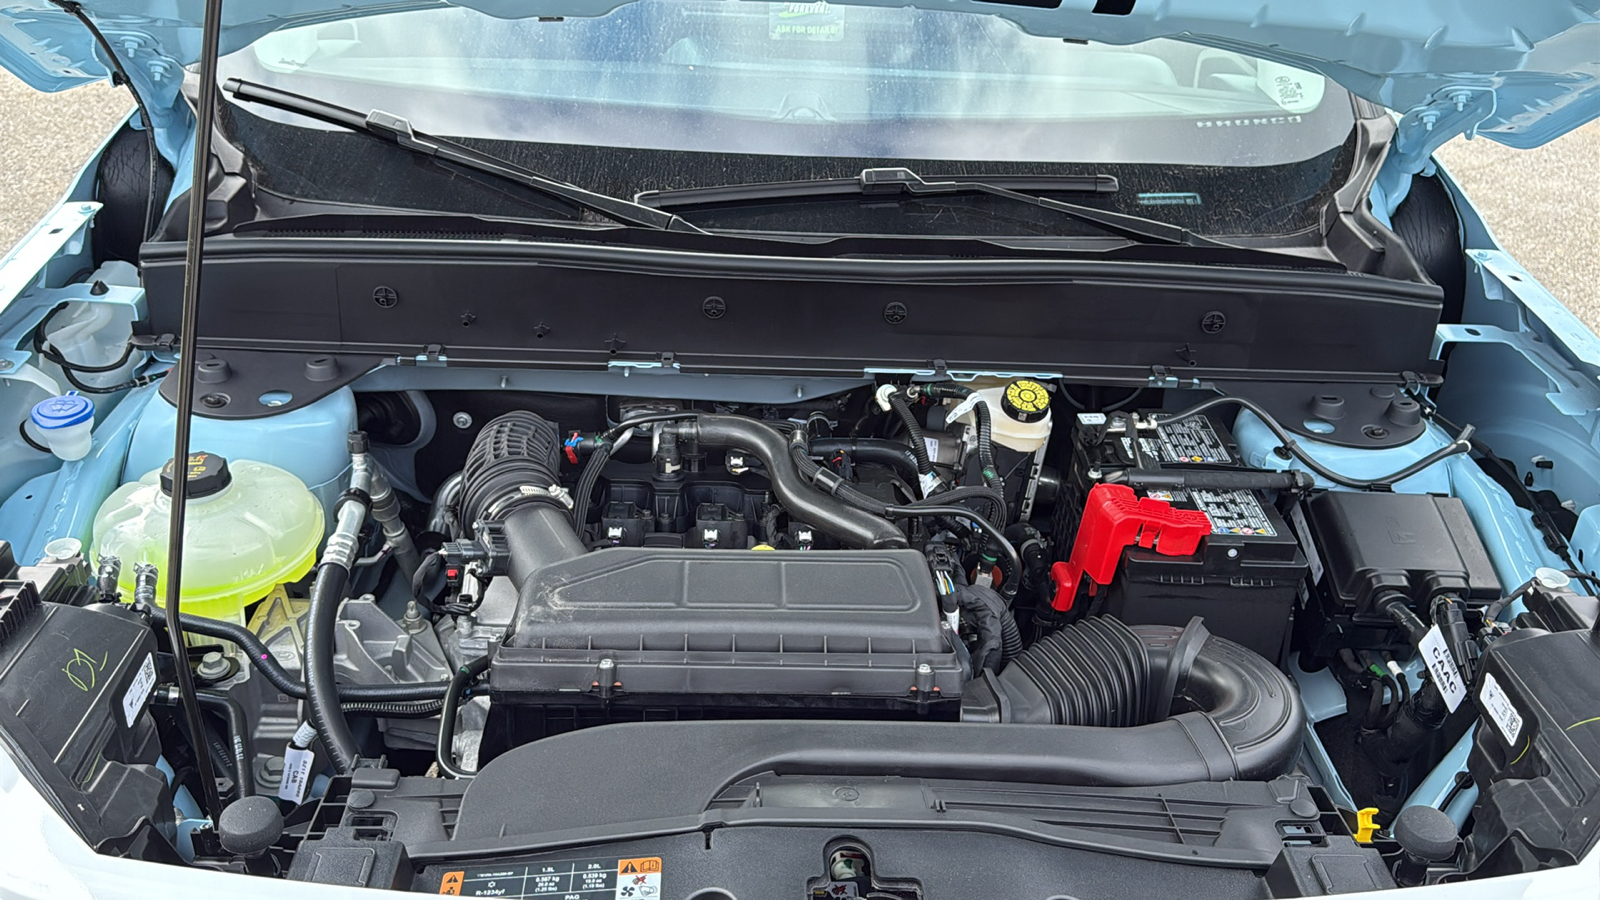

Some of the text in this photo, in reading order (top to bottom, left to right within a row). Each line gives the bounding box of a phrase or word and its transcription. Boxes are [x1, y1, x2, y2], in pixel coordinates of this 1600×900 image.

[776, 25, 838, 35] ASK FOR DETAILS!
[1432, 646, 1457, 694] CAAC
[291, 770, 299, 784] CAB
[475, 888, 505, 896] R-1234yf
